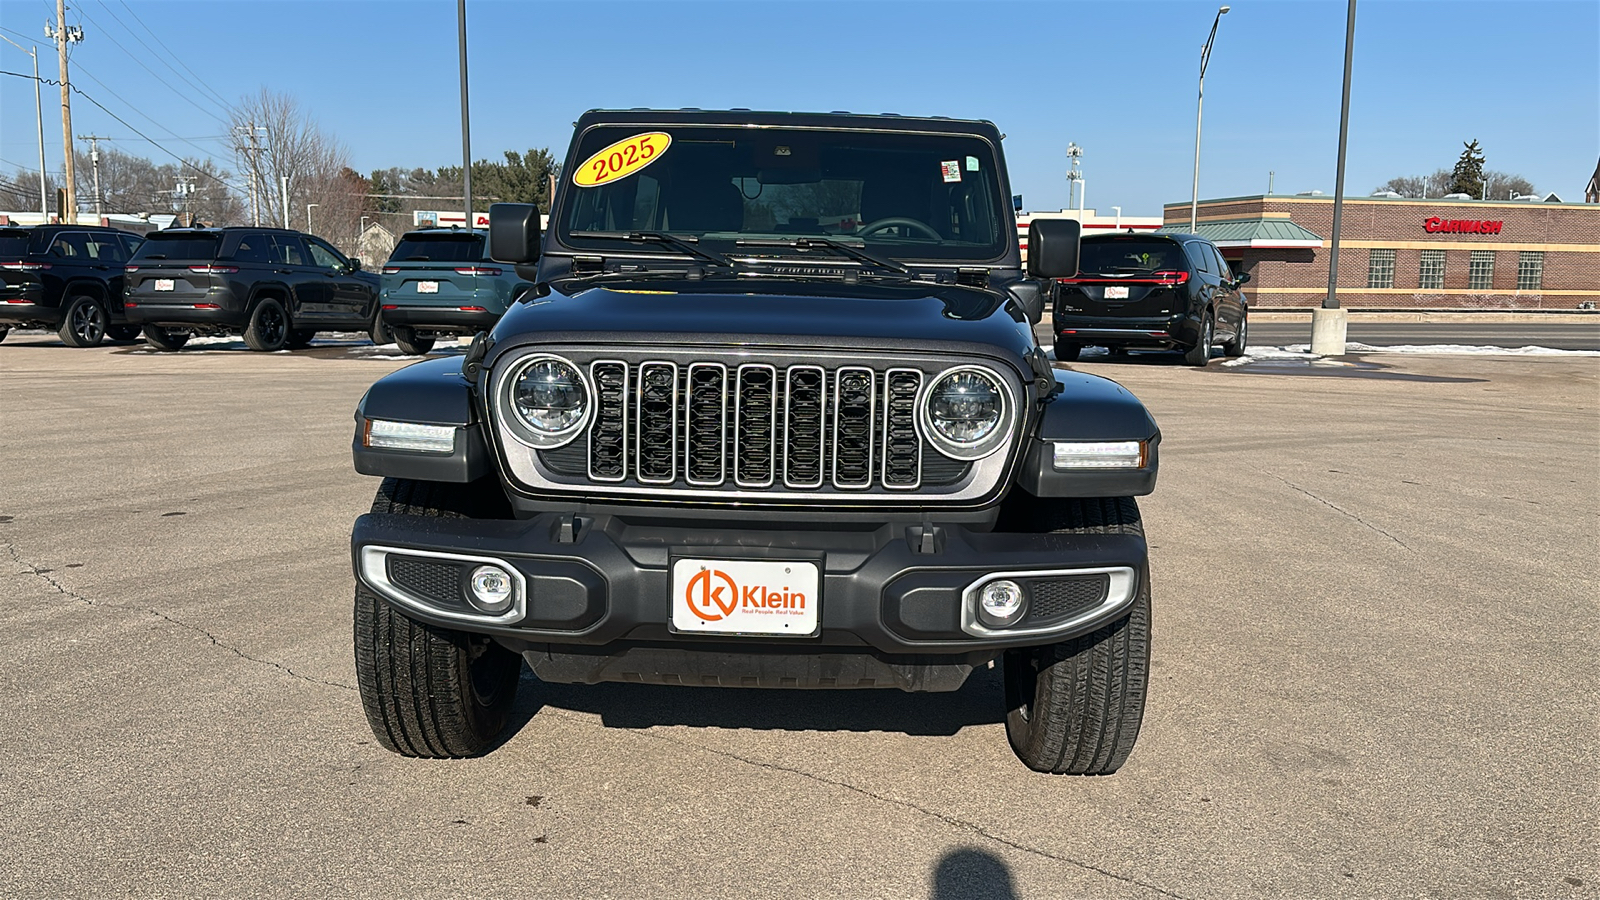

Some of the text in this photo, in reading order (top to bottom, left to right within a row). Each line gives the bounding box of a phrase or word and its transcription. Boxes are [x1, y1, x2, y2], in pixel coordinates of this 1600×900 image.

[592, 136, 655, 182] 2025
[1424, 216, 1503, 234] CARWASH
[742, 585, 806, 609] Klein
